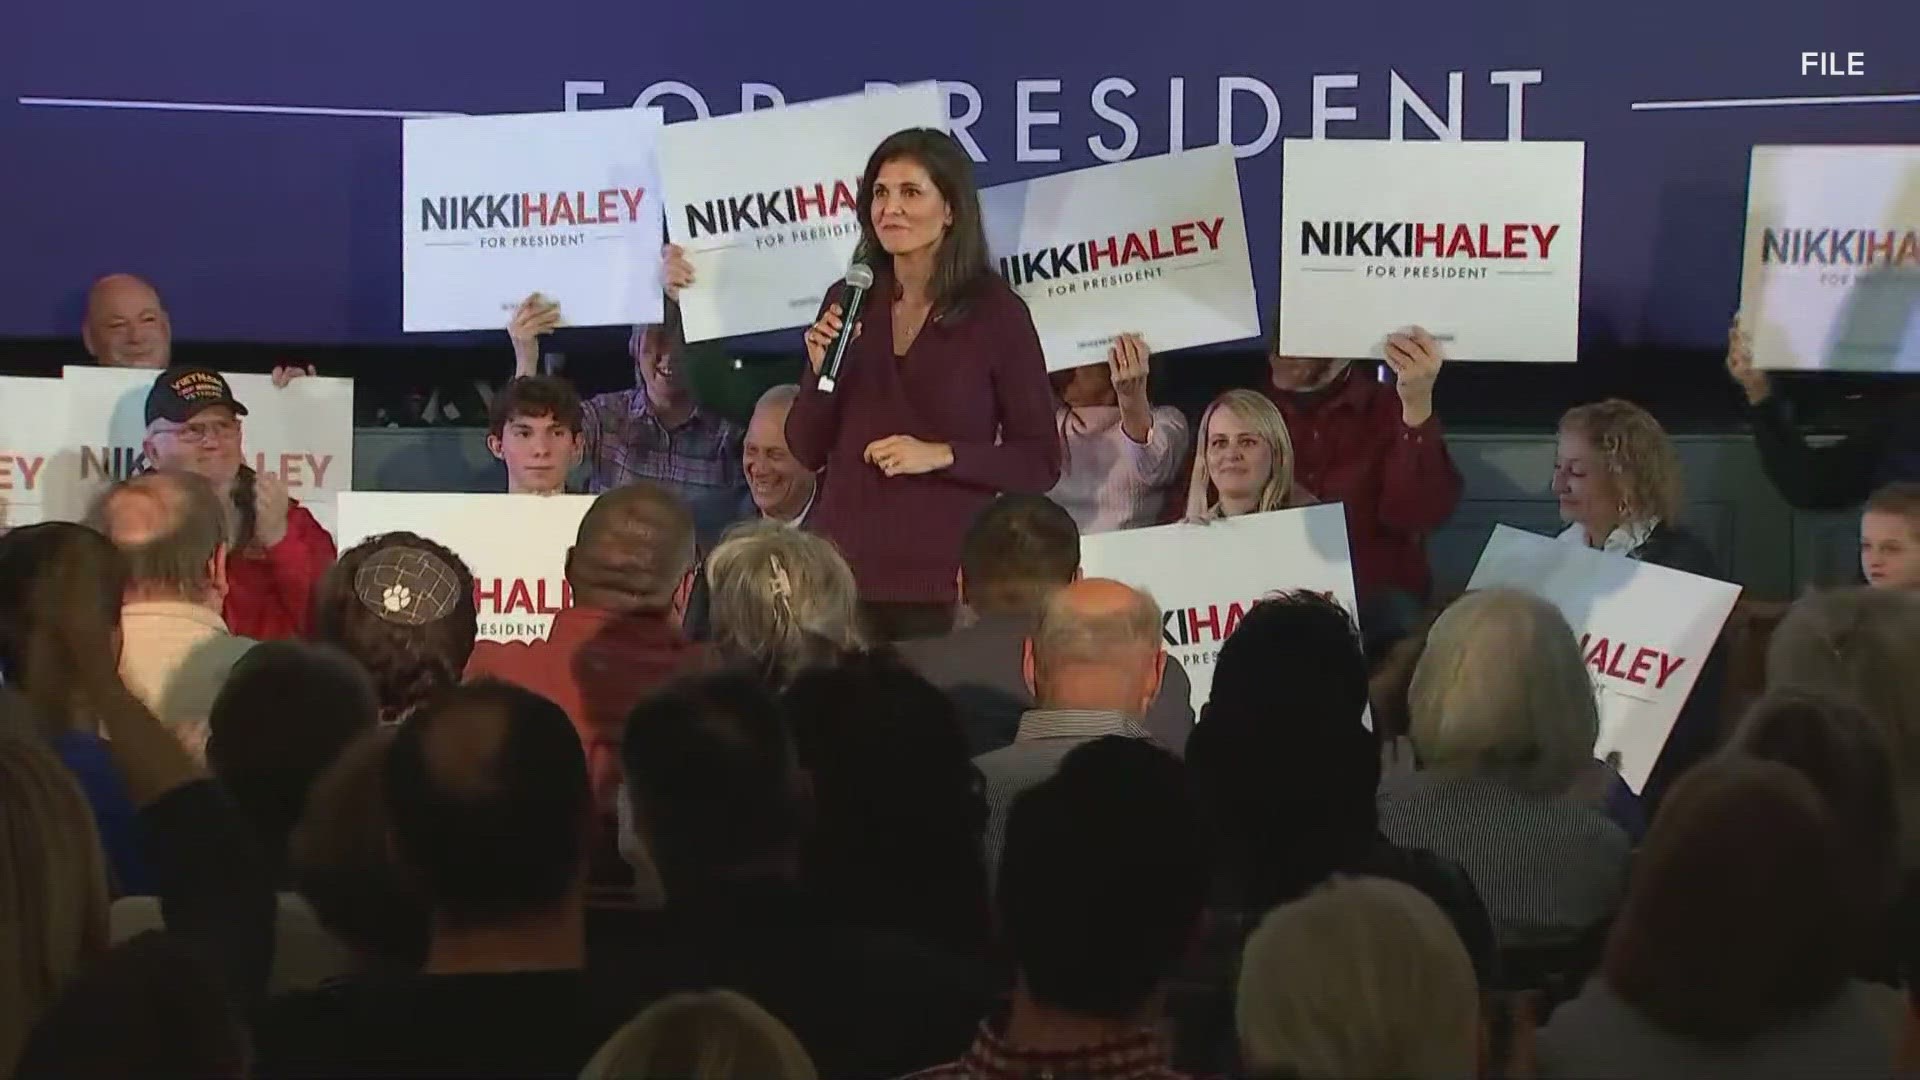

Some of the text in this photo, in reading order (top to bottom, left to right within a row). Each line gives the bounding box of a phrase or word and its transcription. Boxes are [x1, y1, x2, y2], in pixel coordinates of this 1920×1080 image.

[864, 69, 1543, 163] RESIDENT
[421, 187, 646, 232] NIKKIHALEY
[685, 175, 864, 239] NIKKIHA
[480, 233, 585, 249] FOR PRESIDENT
[755, 233, 784, 251] FOR
[1301, 220, 1560, 259] NIKKIHALEY
[1761, 227, 1920, 266] NIKKIHA
[1048, 267, 1163, 298] FOR PRESIDENT
[1365, 265, 1488, 279] FOR PRESIDENT
[480, 623, 546, 636] ESIDENT
